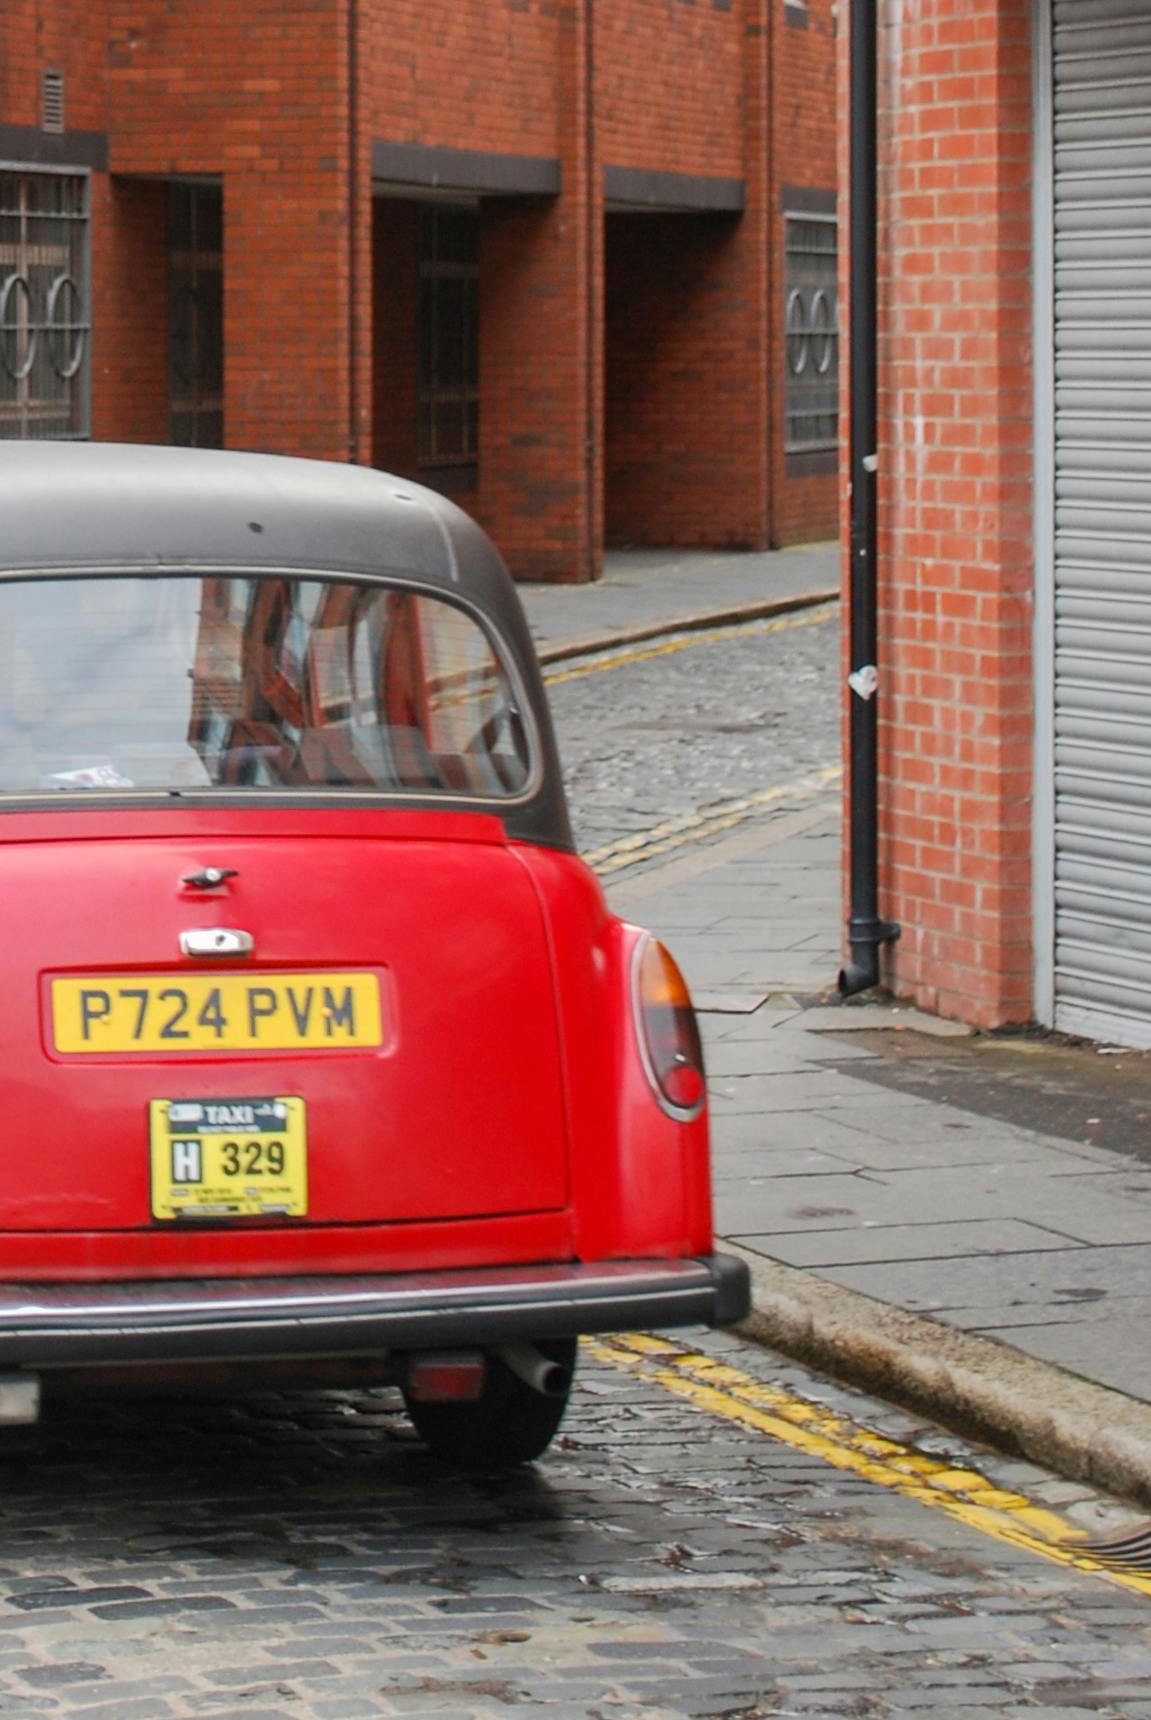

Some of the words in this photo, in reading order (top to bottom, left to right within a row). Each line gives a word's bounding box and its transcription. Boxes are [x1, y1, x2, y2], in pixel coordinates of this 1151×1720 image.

[80, 987, 228, 1040] P724
[245, 985, 356, 1038] PVM
[206, 1105, 254, 1124] TAXI
[173, 1142, 201, 1181] H
[221, 1141, 285, 1176] 329
